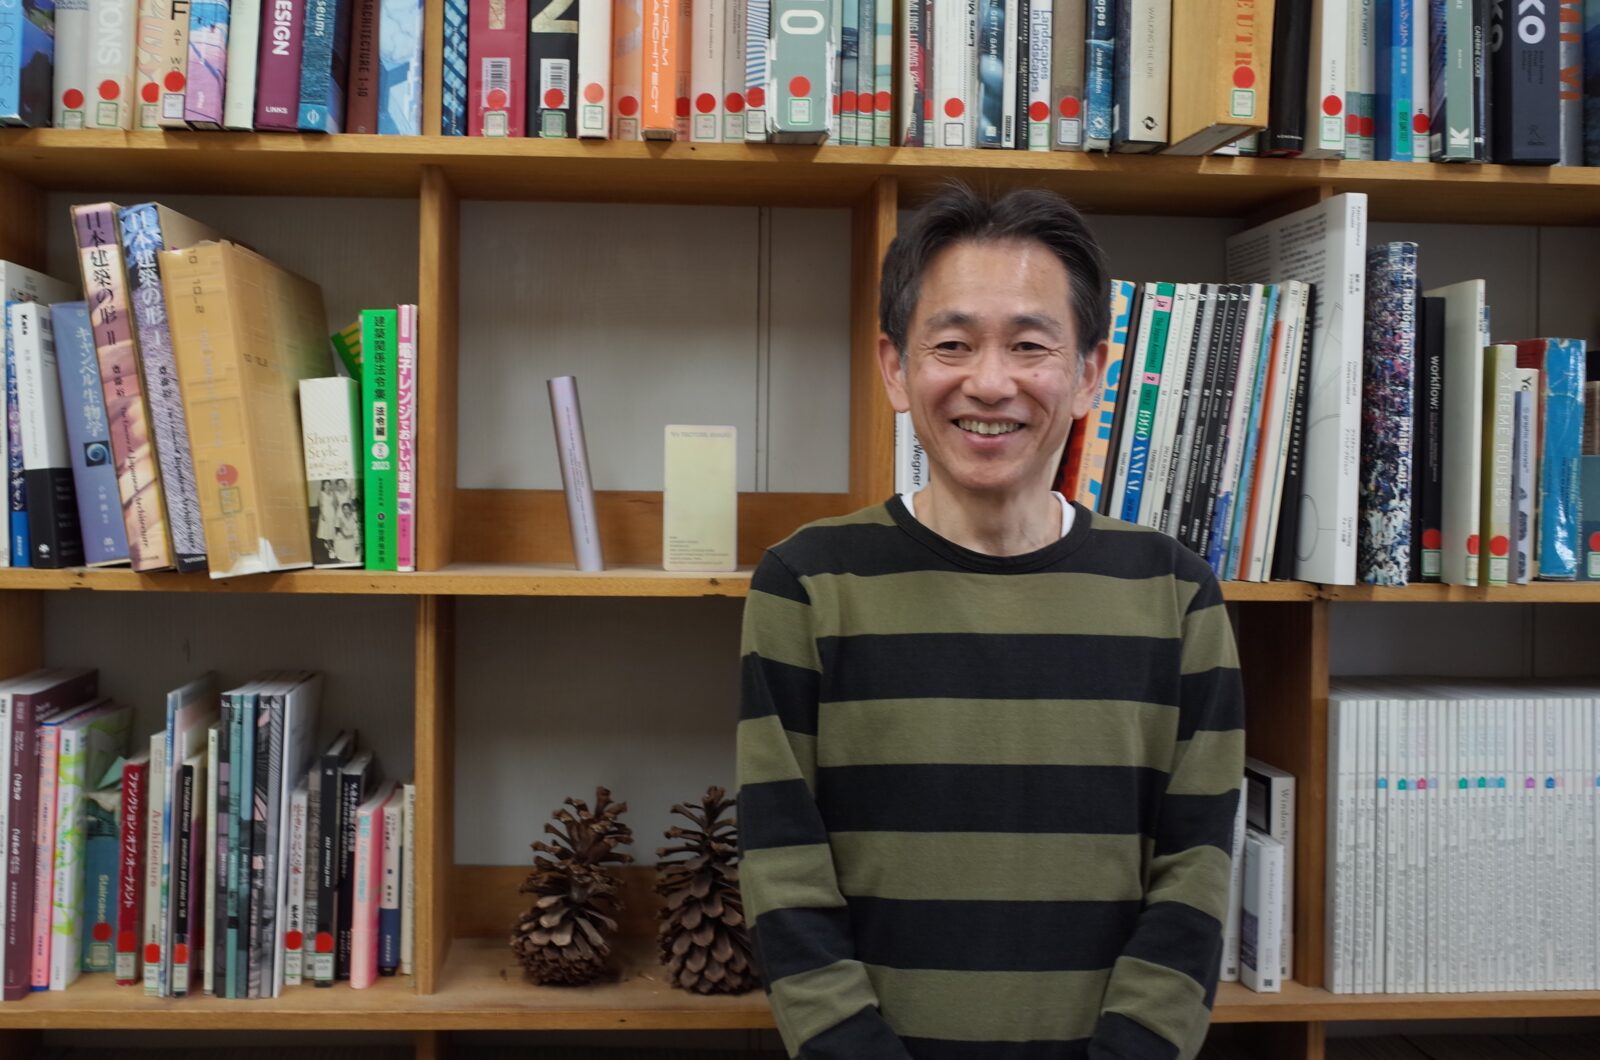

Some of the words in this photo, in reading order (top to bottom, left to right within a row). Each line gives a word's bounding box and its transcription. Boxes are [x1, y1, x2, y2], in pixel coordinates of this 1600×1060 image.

[1033, 10, 1041, 20] in
[1038, 10, 1052, 80] Landscapes
[1028, 22, 1041, 93] Landscapes
[266, 105, 288, 115] LINKS
[1429, 355, 1441, 410] workflow:
[1497, 371, 1511, 438] XTREME
[1495, 443, 1509, 507] HOUSES
[123, 772, 140, 909] ファンクション・オブ・オーナメント
[151, 808, 162, 888] Architecture
